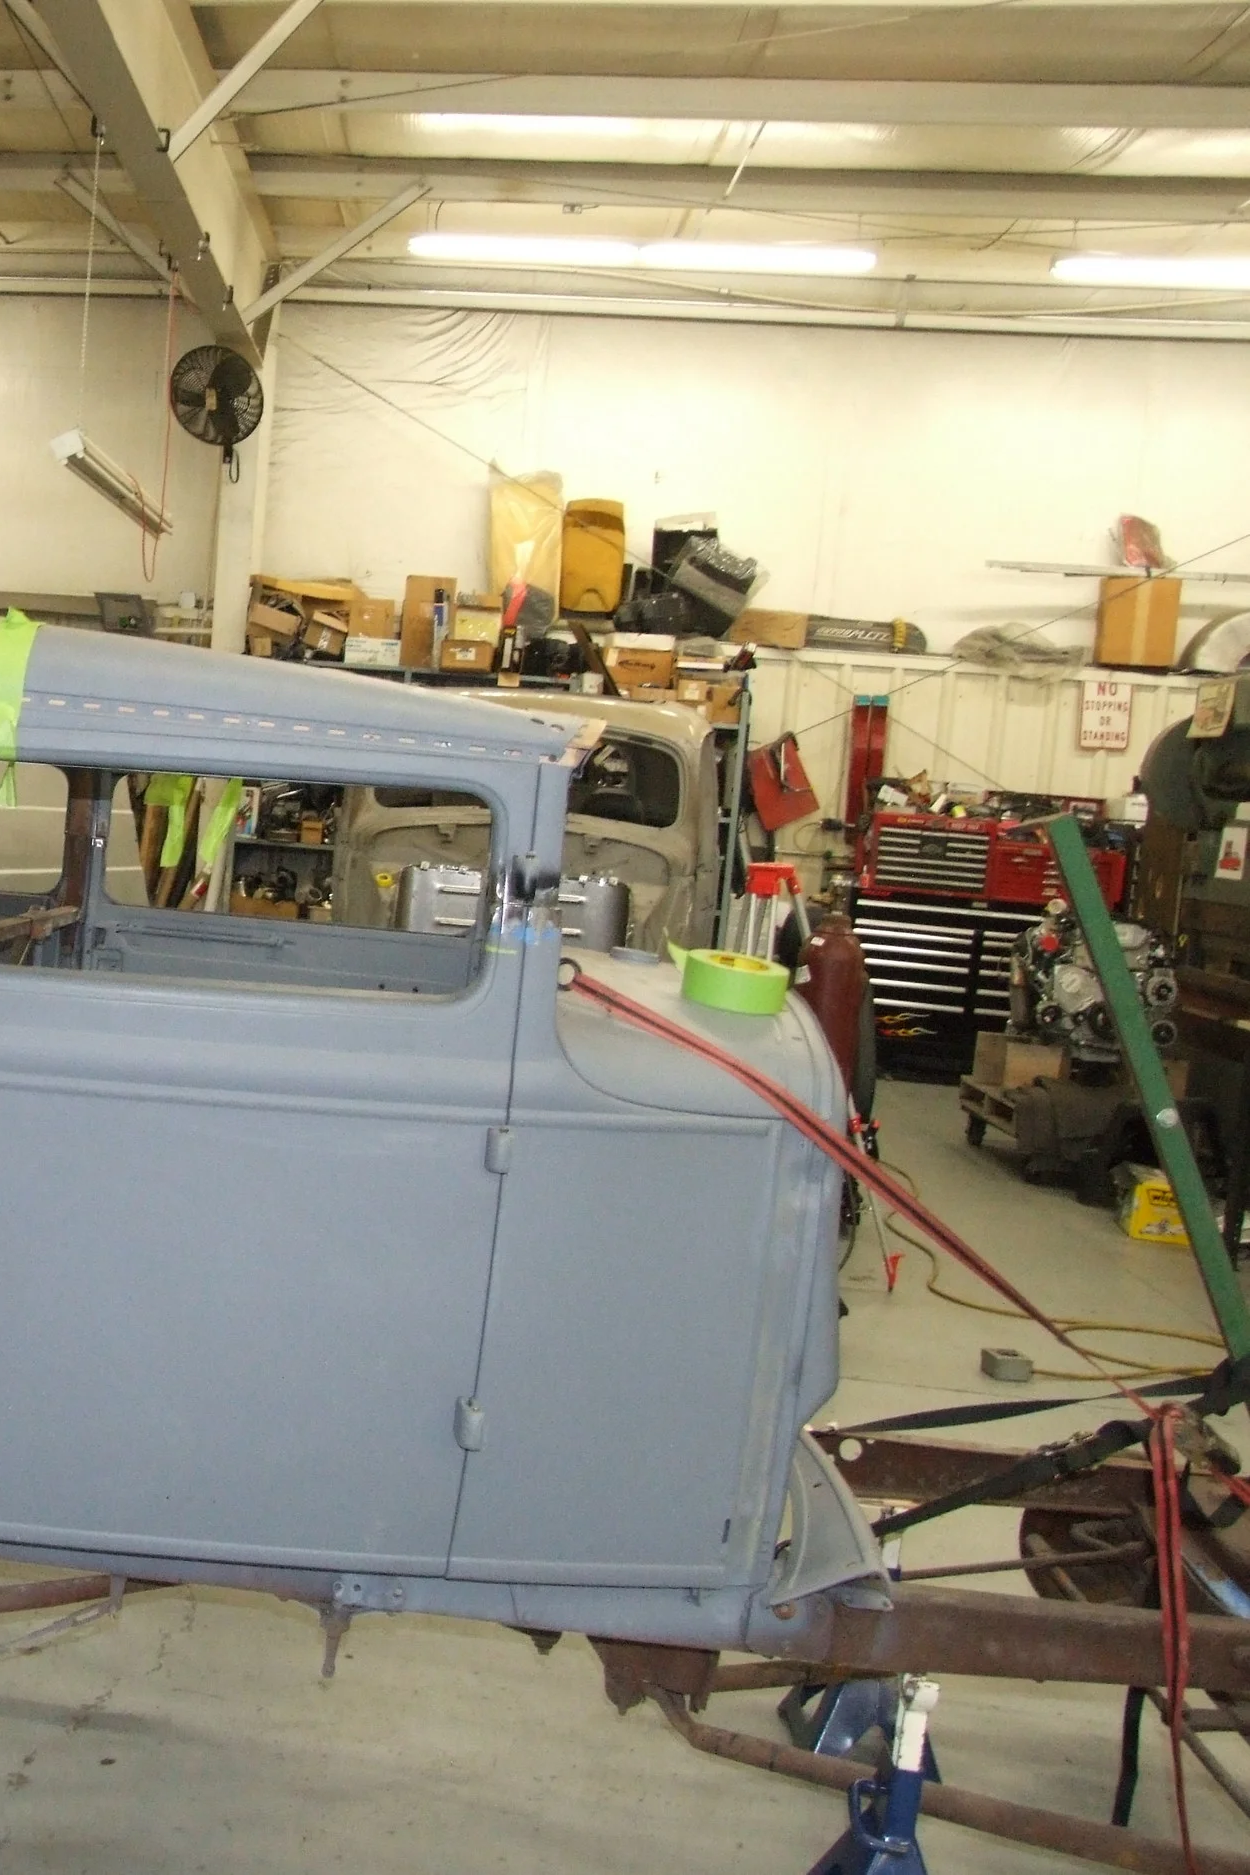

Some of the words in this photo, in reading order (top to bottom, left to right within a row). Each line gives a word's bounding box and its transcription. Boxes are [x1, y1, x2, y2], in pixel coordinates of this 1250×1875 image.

[1097, 682, 1117, 697] NO
[1085, 700, 1129, 712] STOPPING
[1099, 715, 1111, 726] OR
[1082, 730, 1127, 742] STANDING
